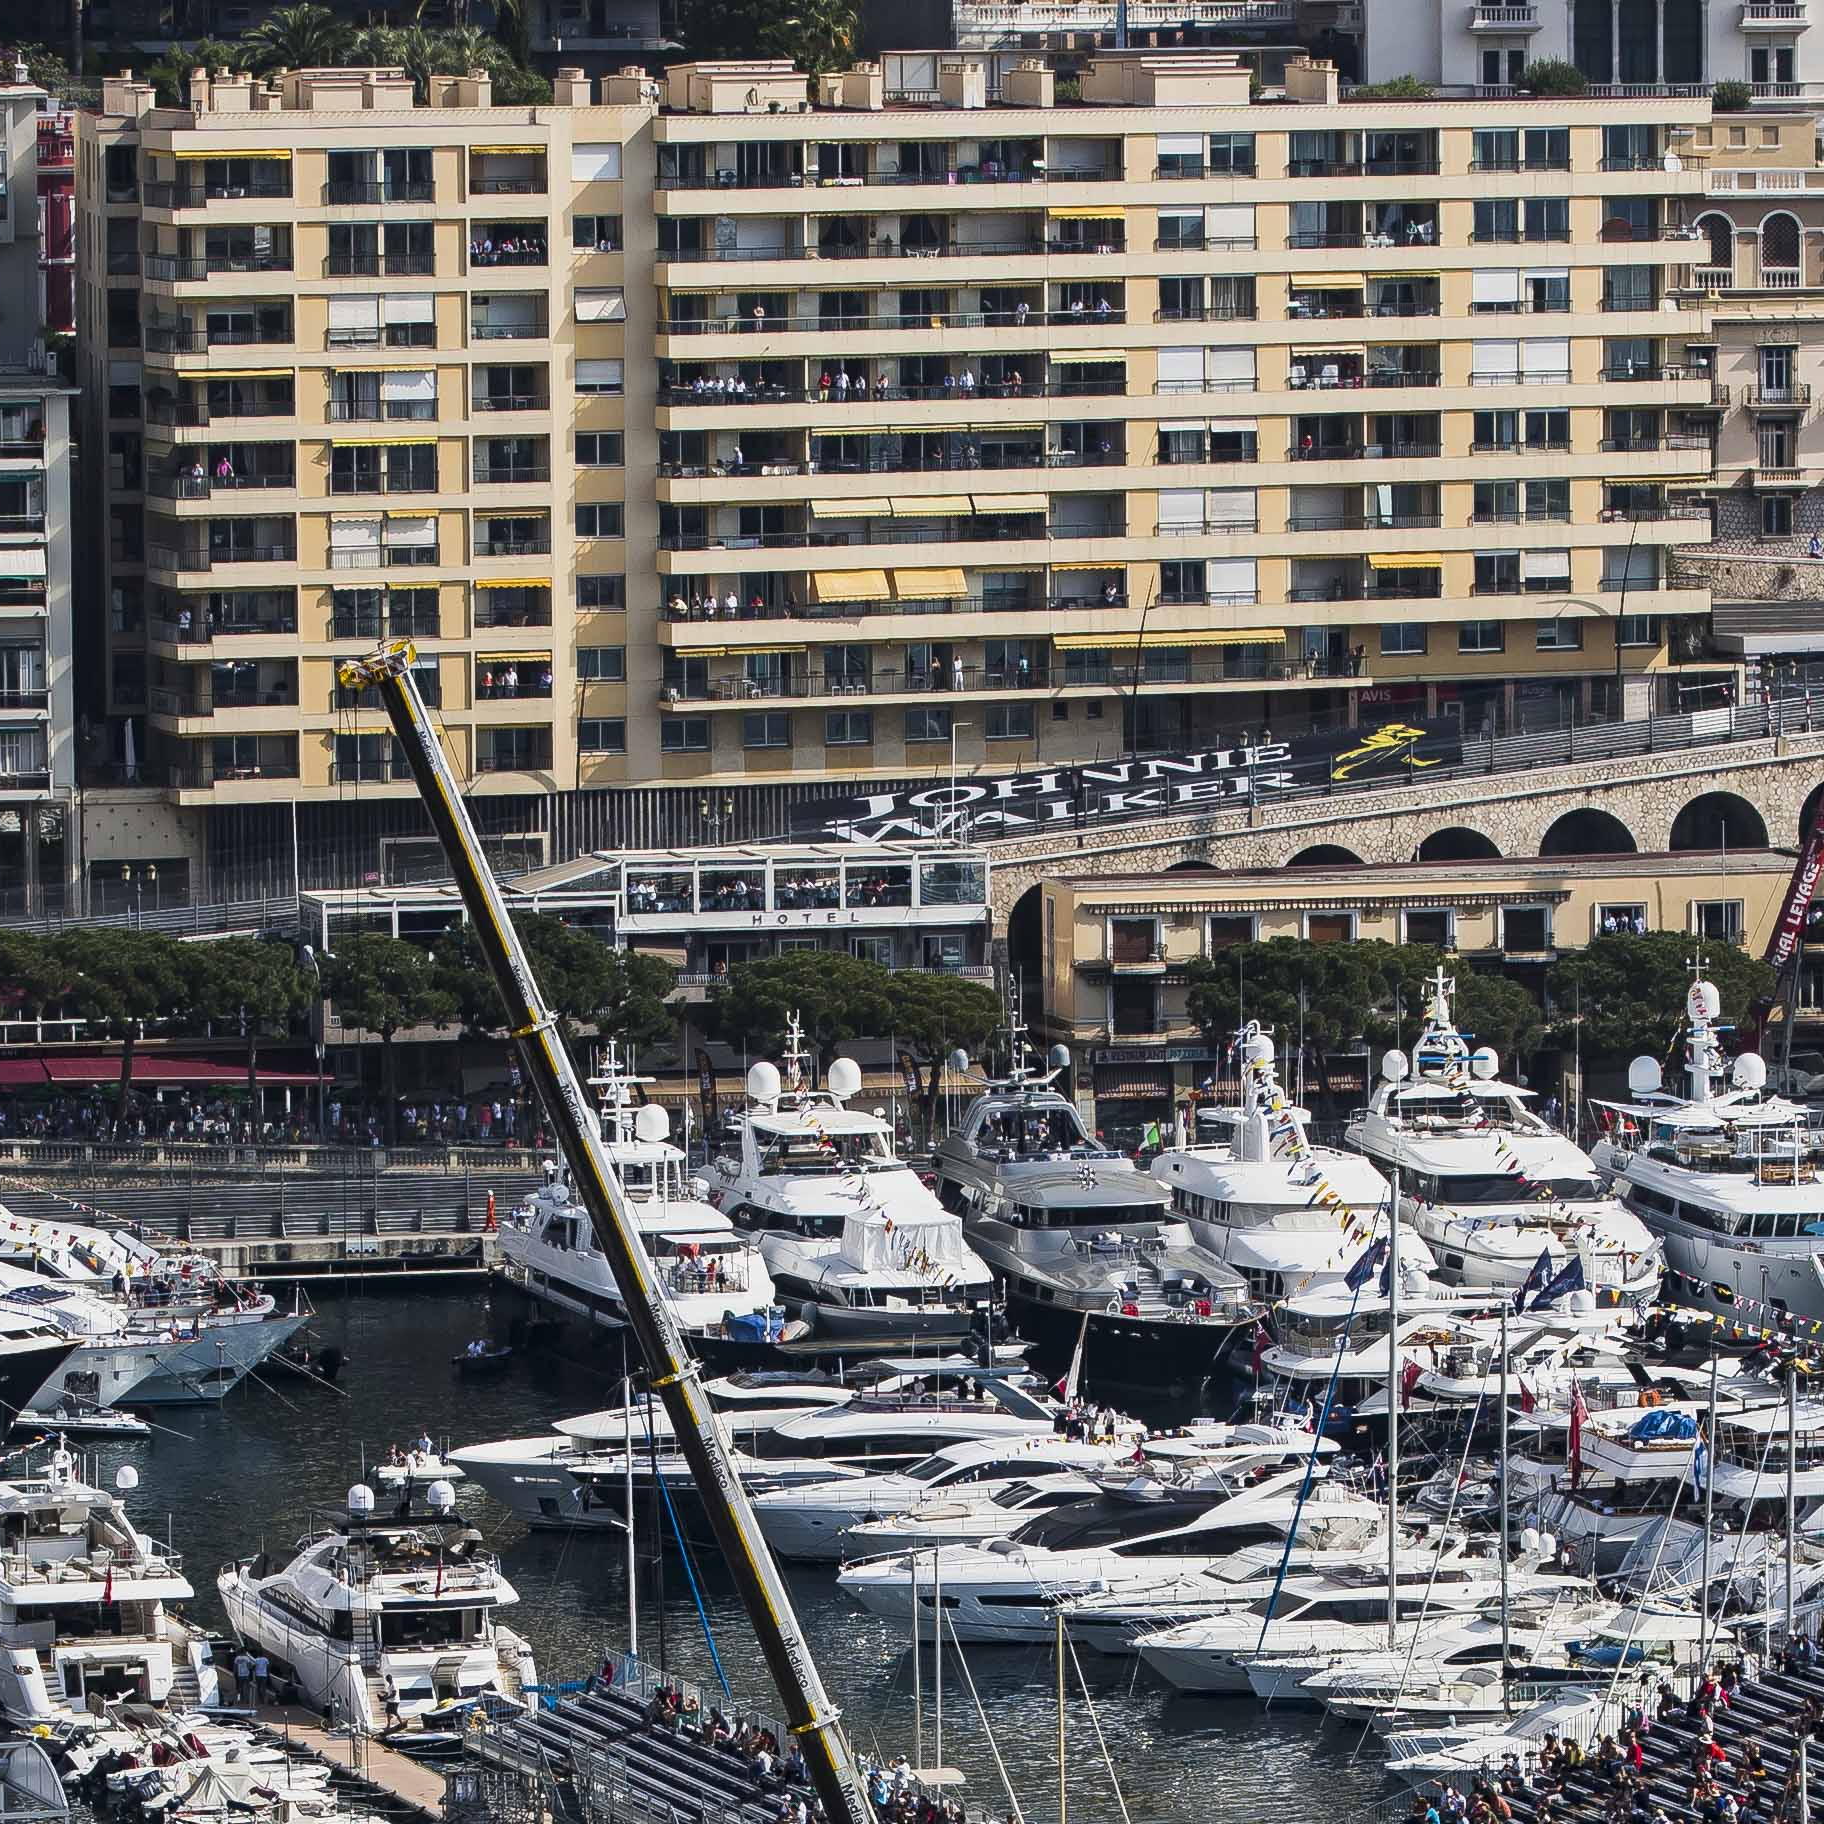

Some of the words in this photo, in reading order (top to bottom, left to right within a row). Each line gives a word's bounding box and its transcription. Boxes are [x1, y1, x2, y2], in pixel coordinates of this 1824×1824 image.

[1360, 689, 1391, 702] AVIS
[850, 742, 1294, 820] JOHNNIE
[824, 771, 1317, 843] WALKER
[752, 912, 859, 926] HOTEL
[1787, 862, 1820, 927] LEVAGE
[561, 1084, 582, 1127] Mediaco
[649, 1303, 671, 1346] Mediaco
[703, 1437, 728, 1488] Mediaco
[783, 1636, 808, 1689] Mediaco
